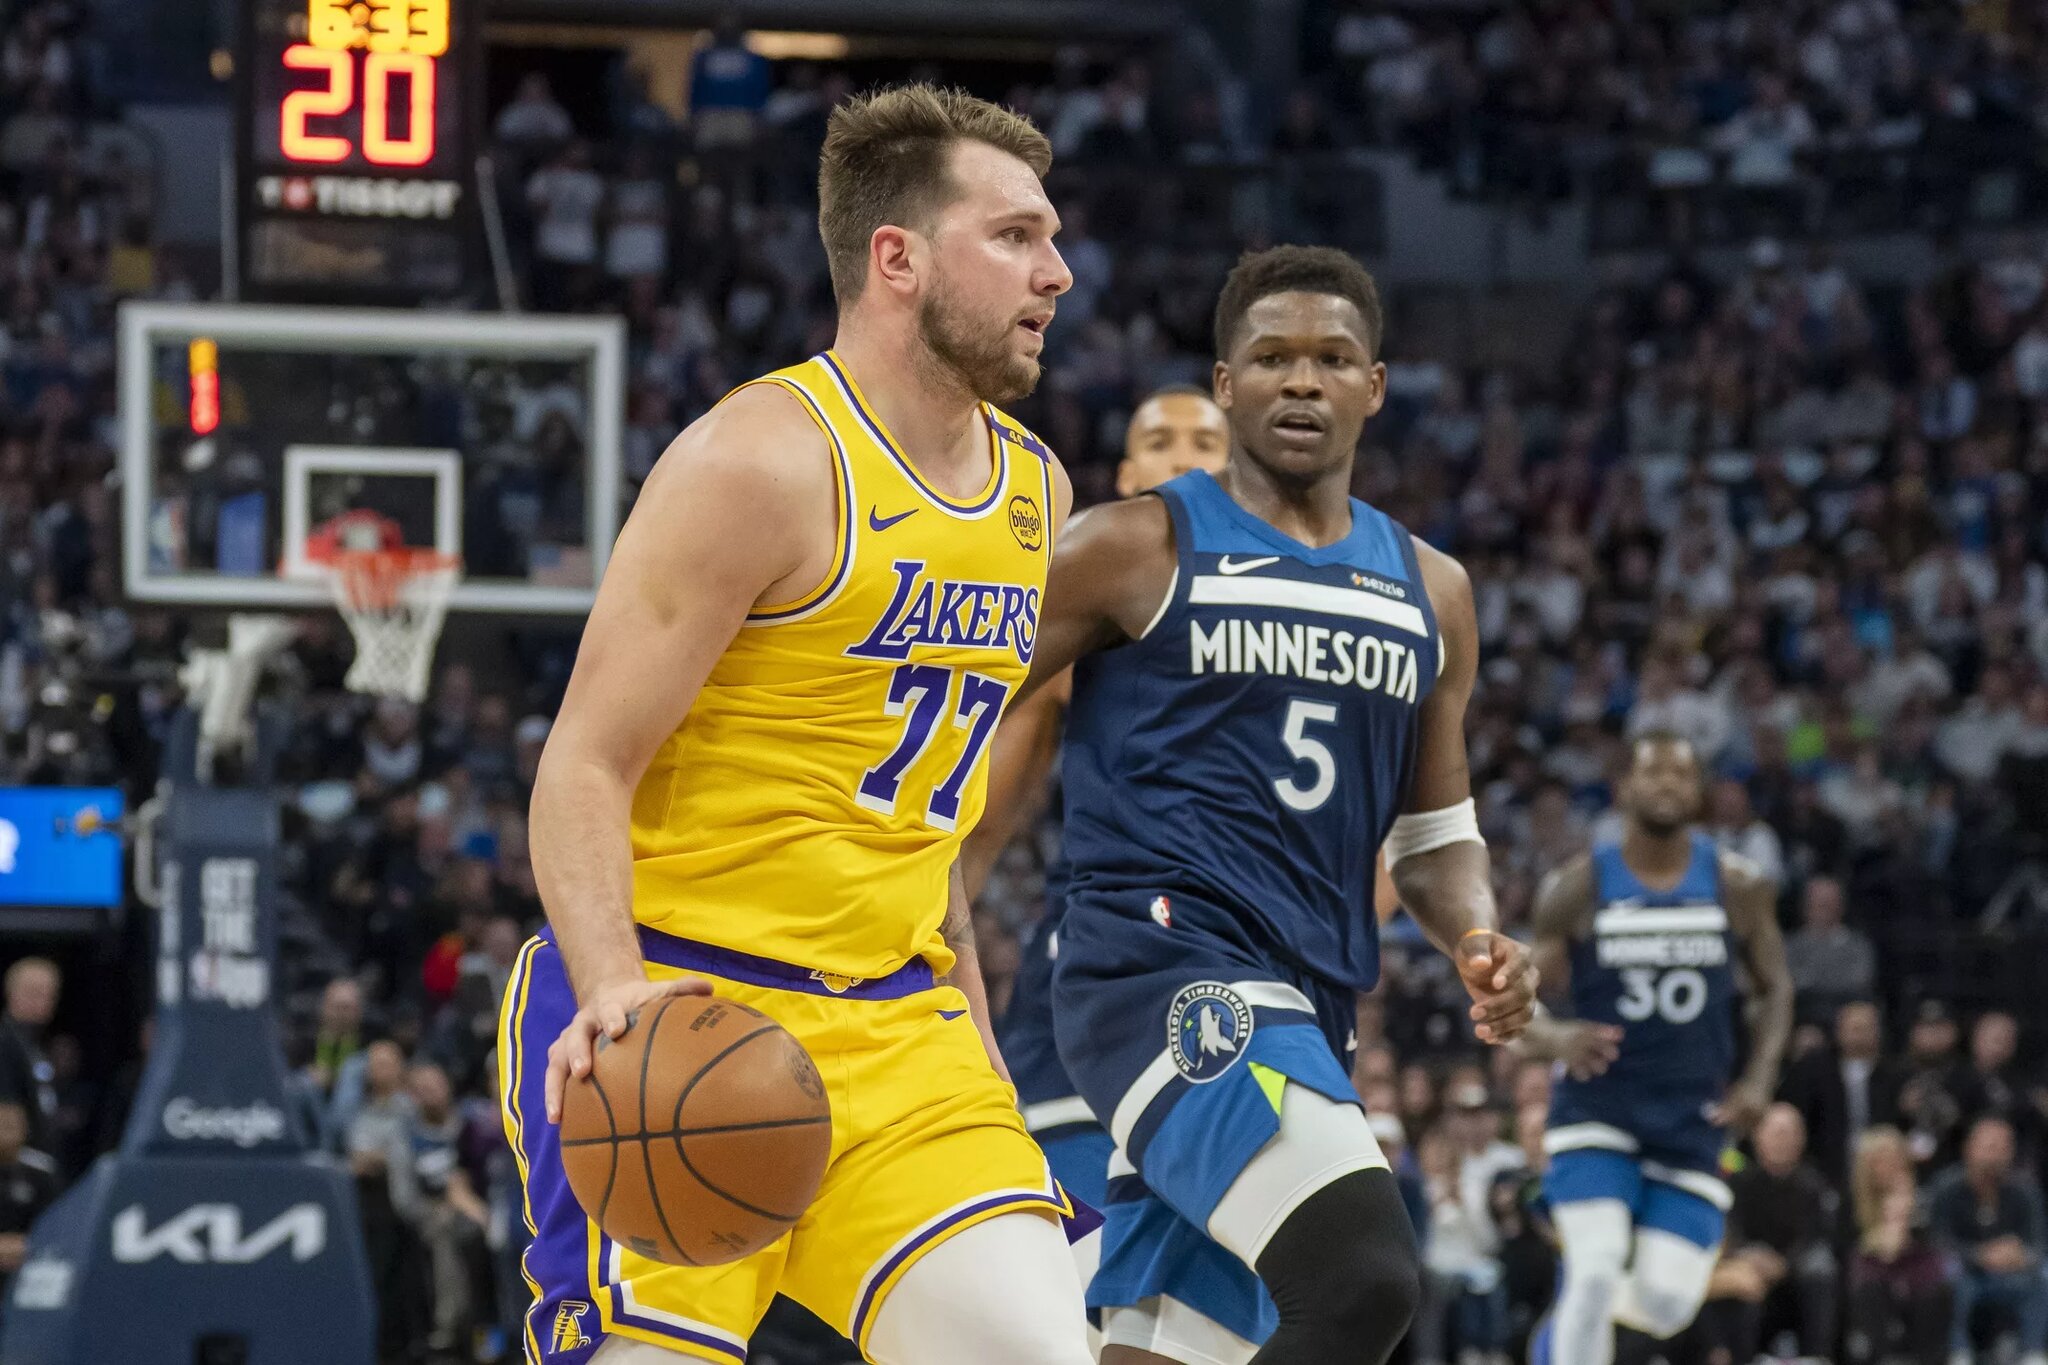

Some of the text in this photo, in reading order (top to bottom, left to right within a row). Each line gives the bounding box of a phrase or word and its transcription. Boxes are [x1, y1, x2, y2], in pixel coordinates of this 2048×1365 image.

[281, 44, 436, 167] 20
[314, 177, 461, 220] TISSOT
[1011, 510, 1040, 536] bibigo
[841, 559, 1040, 667] LAKERS
[1362, 576, 1406, 599] sezzle
[1190, 618, 1418, 704] MINNESOTA
[854, 663, 1012, 834] 77
[1273, 698, 1339, 813] 5
[1183, 985, 1249, 1038] TIMBERWOLVES
[1615, 968, 1708, 1025] 30
[163, 1096, 285, 1149] Google
